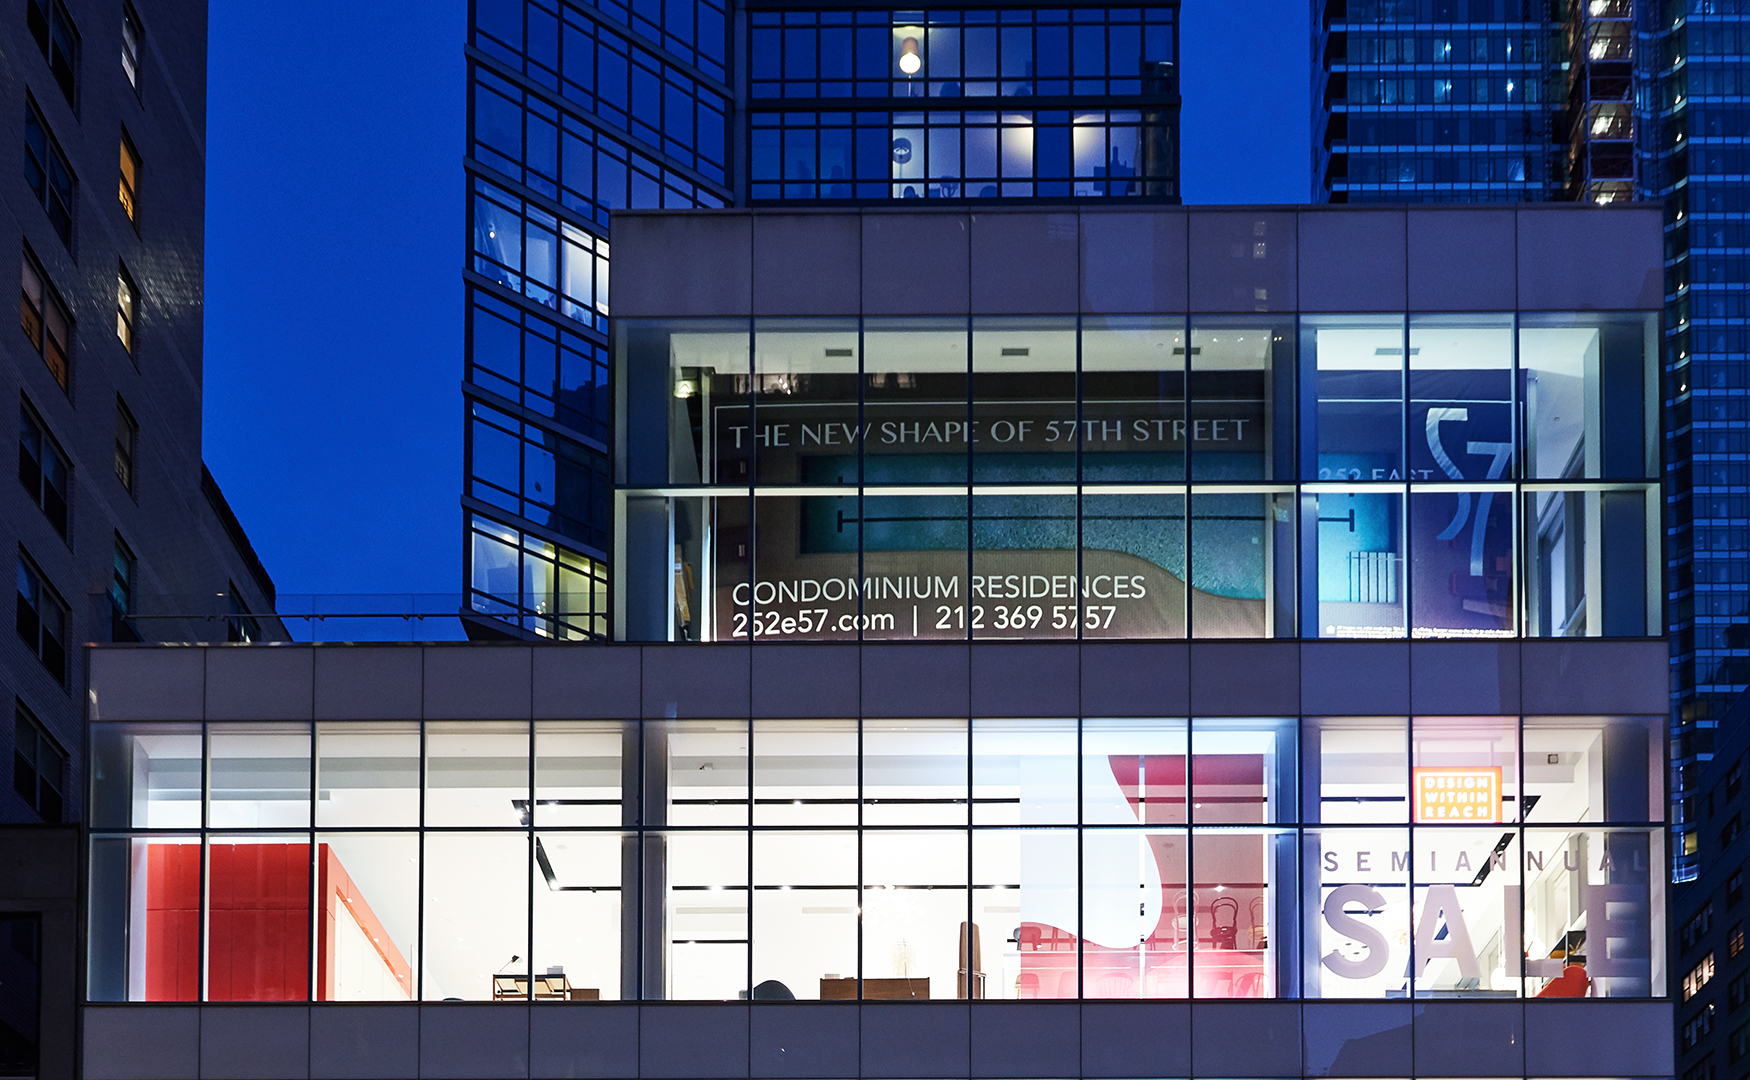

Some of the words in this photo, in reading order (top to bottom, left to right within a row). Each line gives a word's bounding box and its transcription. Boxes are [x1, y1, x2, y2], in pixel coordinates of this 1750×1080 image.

[728, 424, 790, 448] THE
[801, 422, 872, 446] NEW
[881, 421, 980, 443] SHAPE
[990, 420, 1034, 443] OF
[1045, 420, 1122, 442] 57TH
[1132, 419, 1250, 442] STREET
[1372, 468, 1434, 480] EAT
[732, 575, 959, 606] CONDOMINIUM
[971, 575, 1147, 599] RESIDENCES
[732, 608, 895, 638] 252e57.com
[935, 605, 985, 629] 212
[993, 605, 1043, 629] 369
[1051, 605, 1117, 629] 5757
[1424, 776, 1488, 789] DESIGN
[1424, 791, 1488, 804] WITHIN
[1424, 805, 1488, 818] REACH
[1323, 850, 1648, 872] SEMIANNUAL
[1321, 884, 1650, 980] SALE
